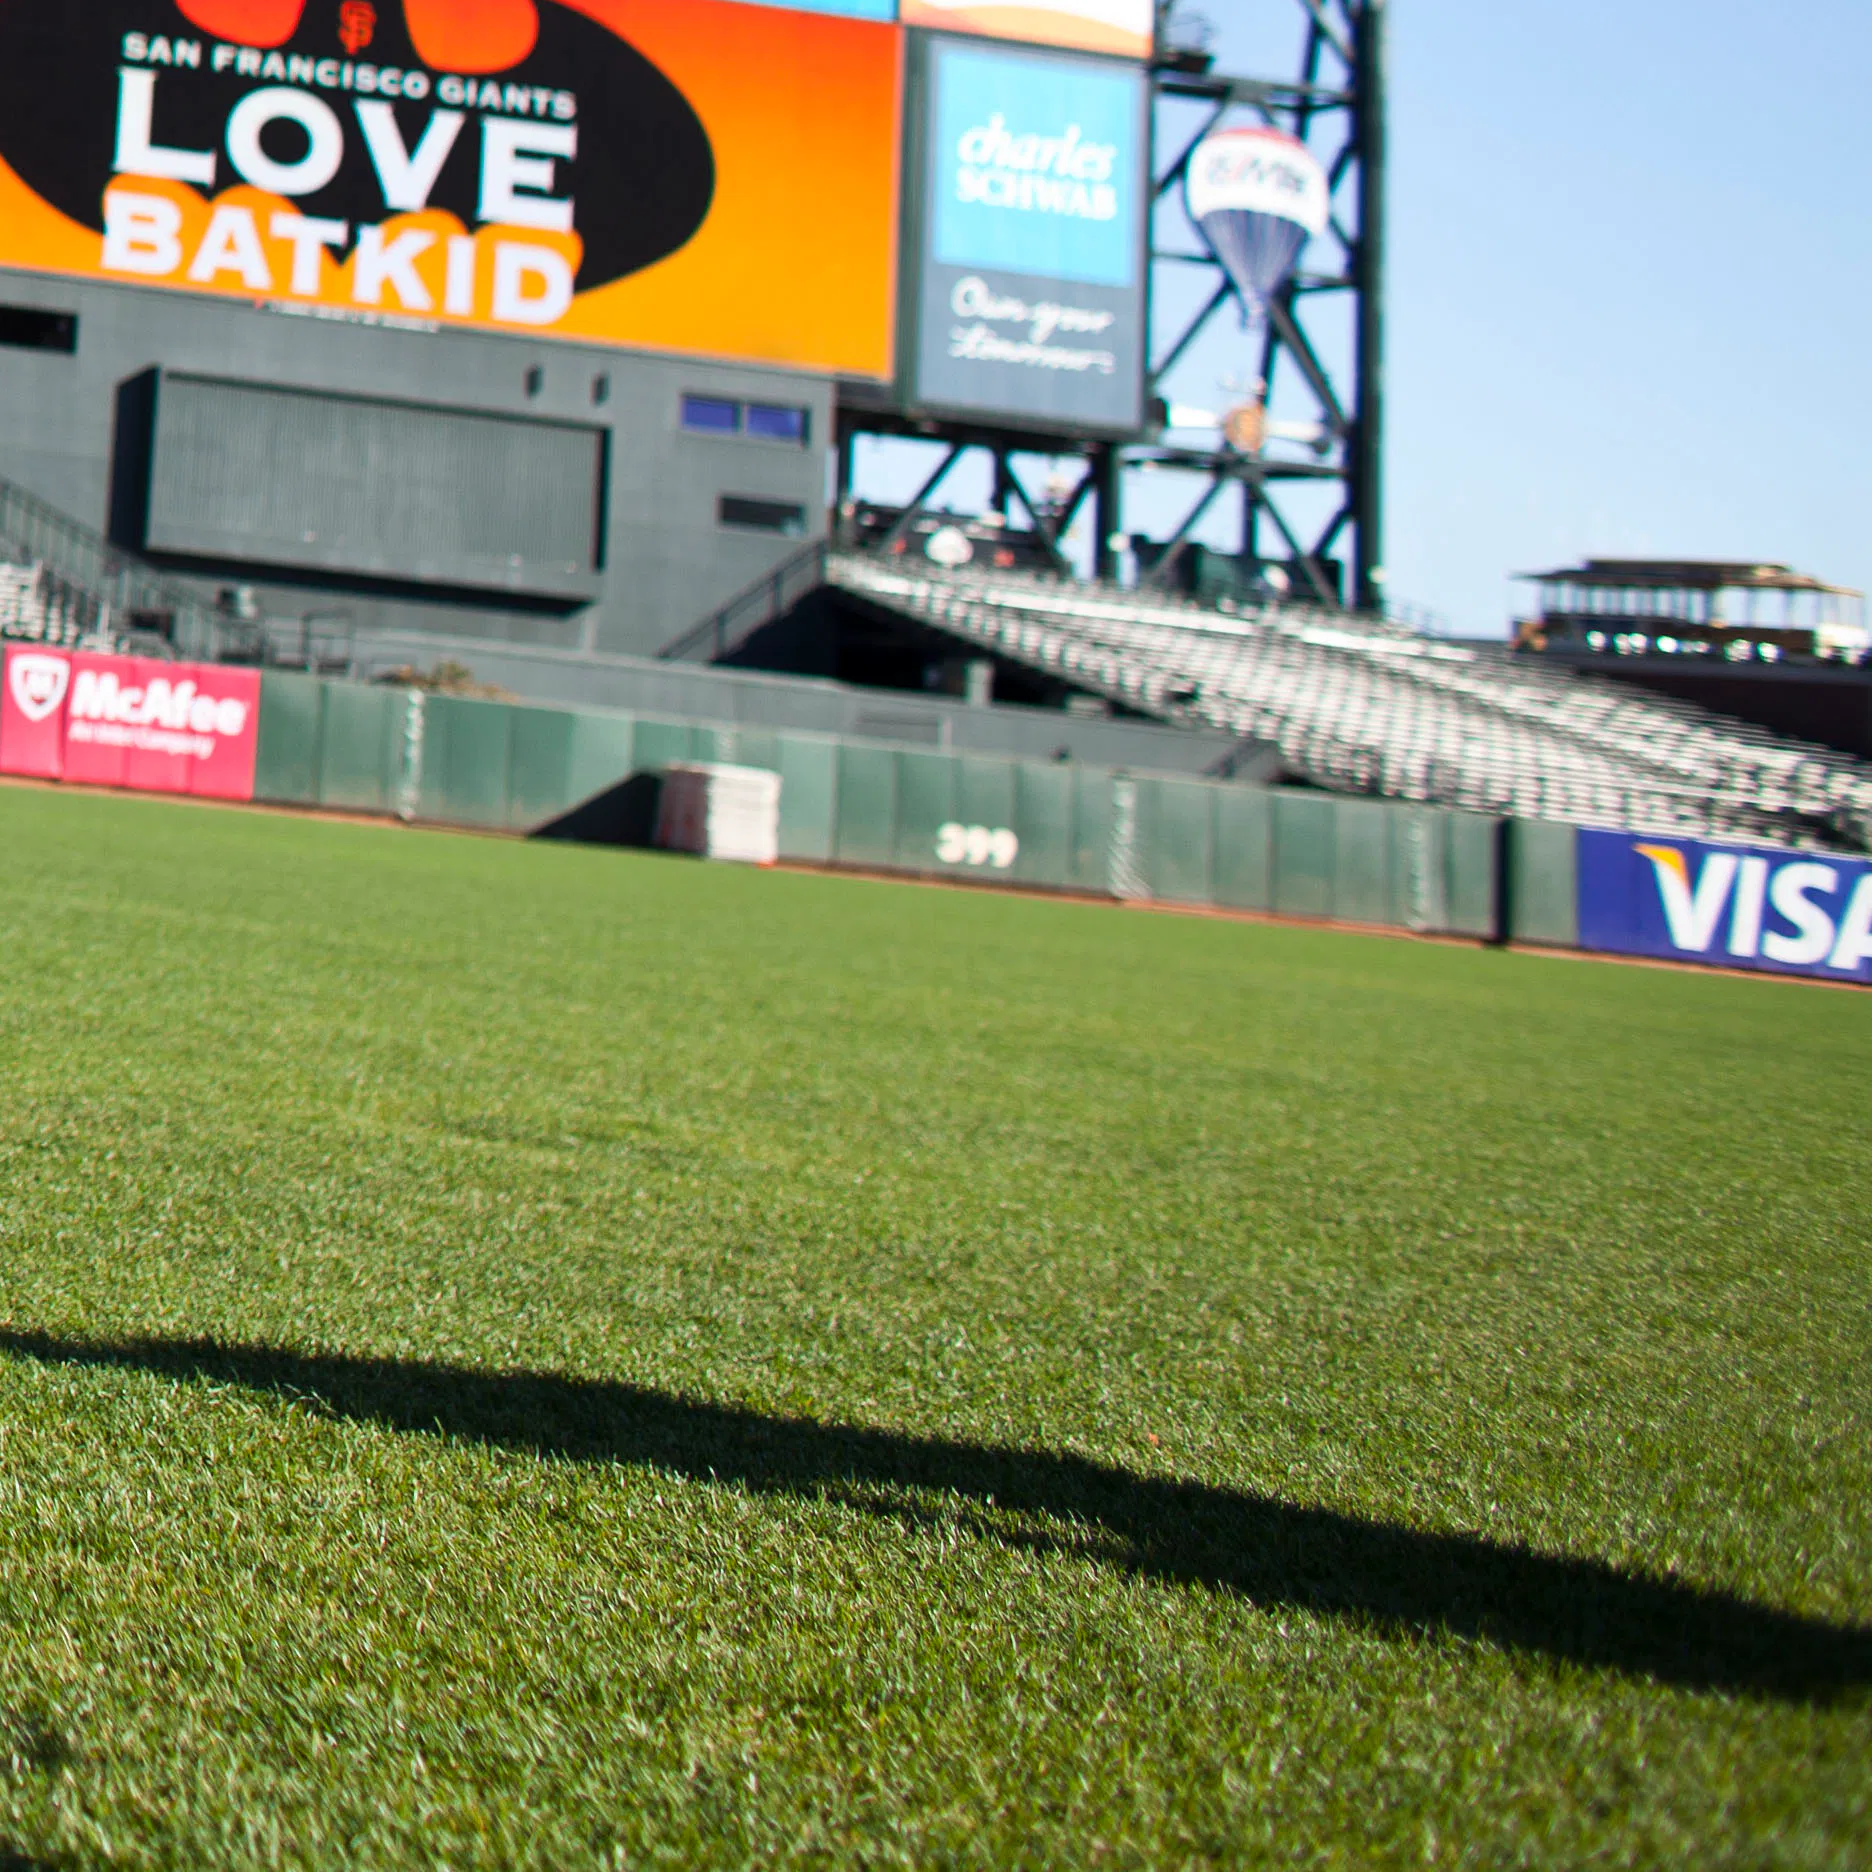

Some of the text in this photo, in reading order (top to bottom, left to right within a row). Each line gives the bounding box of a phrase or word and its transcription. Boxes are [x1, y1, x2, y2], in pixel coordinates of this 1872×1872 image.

[122, 33, 576, 120] SAN FRANCISCO GIANTS
[112, 67, 578, 234] LOVE
[958, 112, 1118, 182] charles
[956, 164, 1117, 220] SCHWAB
[100, 190, 575, 326] BATKID
[69, 668, 246, 736] McAfee
[935, 821, 1019, 868] 399
